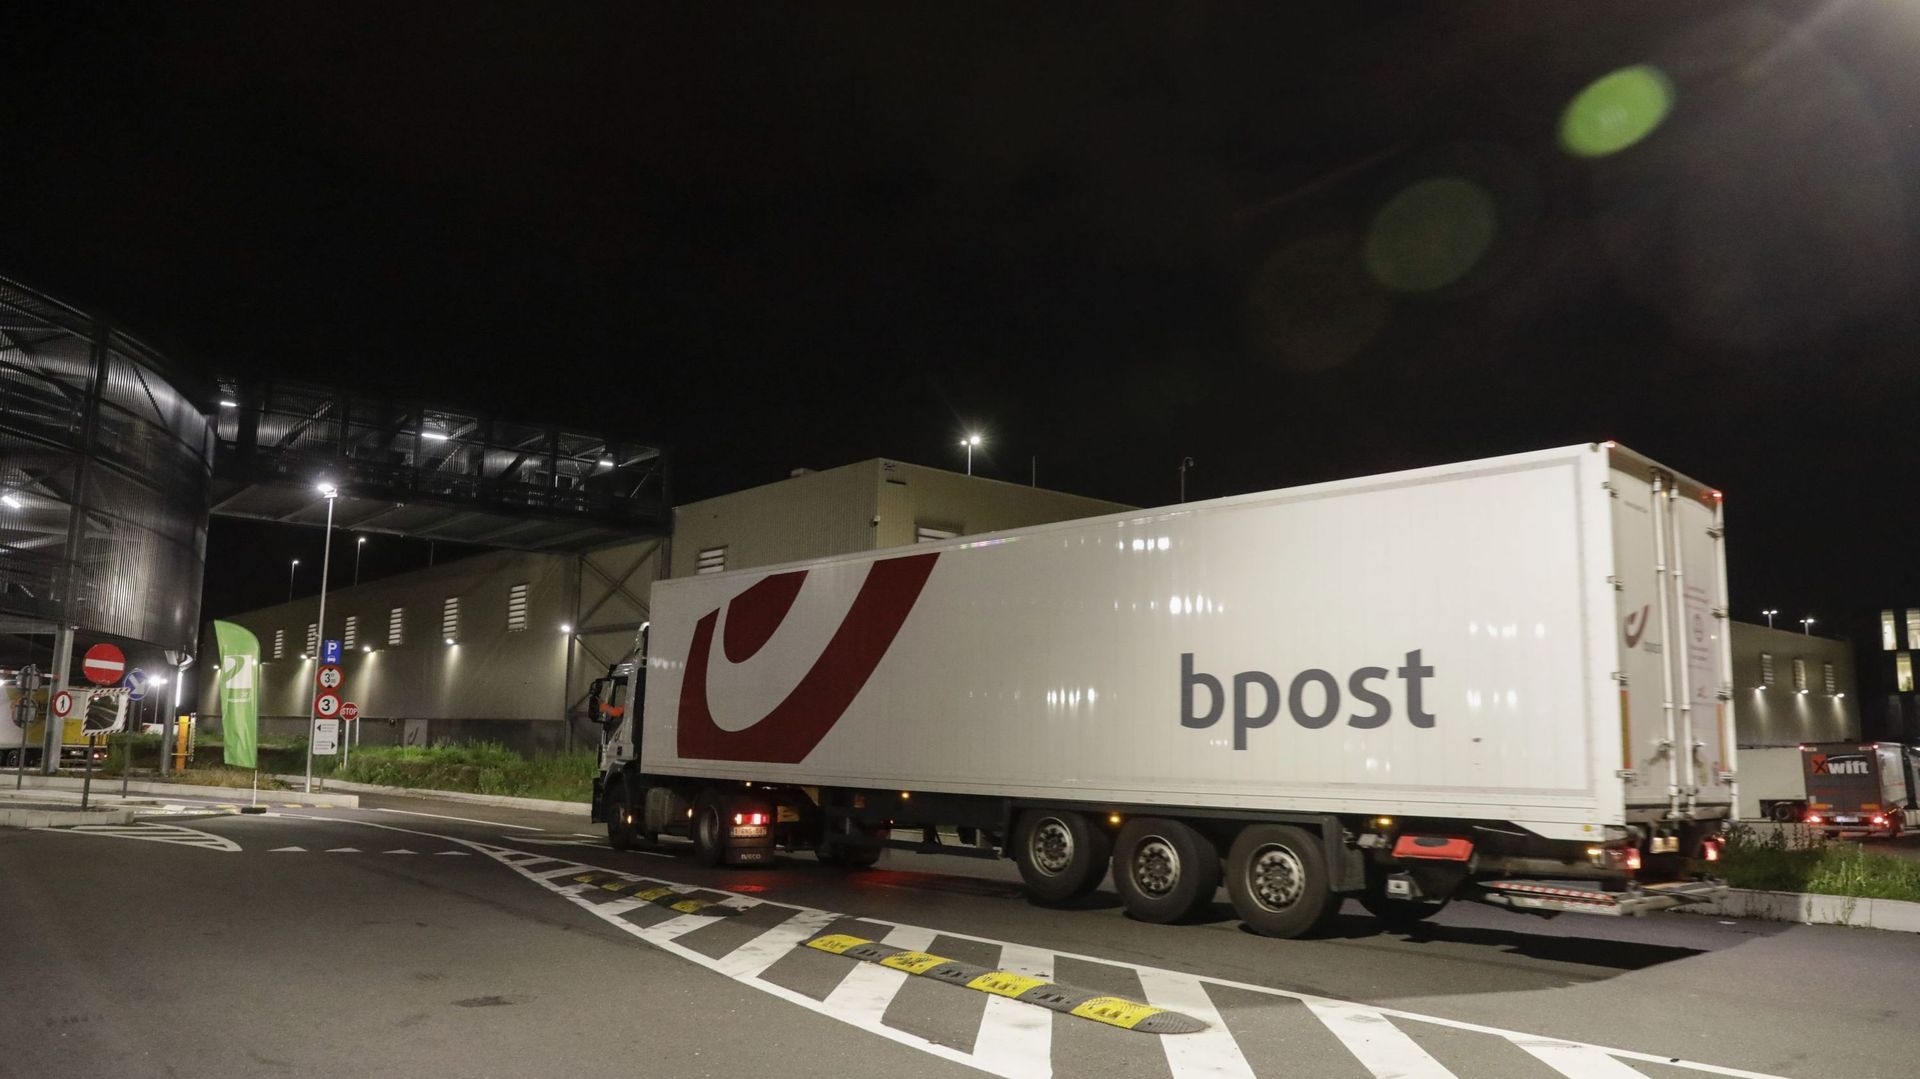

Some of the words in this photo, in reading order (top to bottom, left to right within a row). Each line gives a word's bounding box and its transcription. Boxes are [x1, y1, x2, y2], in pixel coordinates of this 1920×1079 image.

[327, 642, 338, 655] P
[1180, 649, 1436, 751] bpost
[341, 707, 358, 716] STOP
